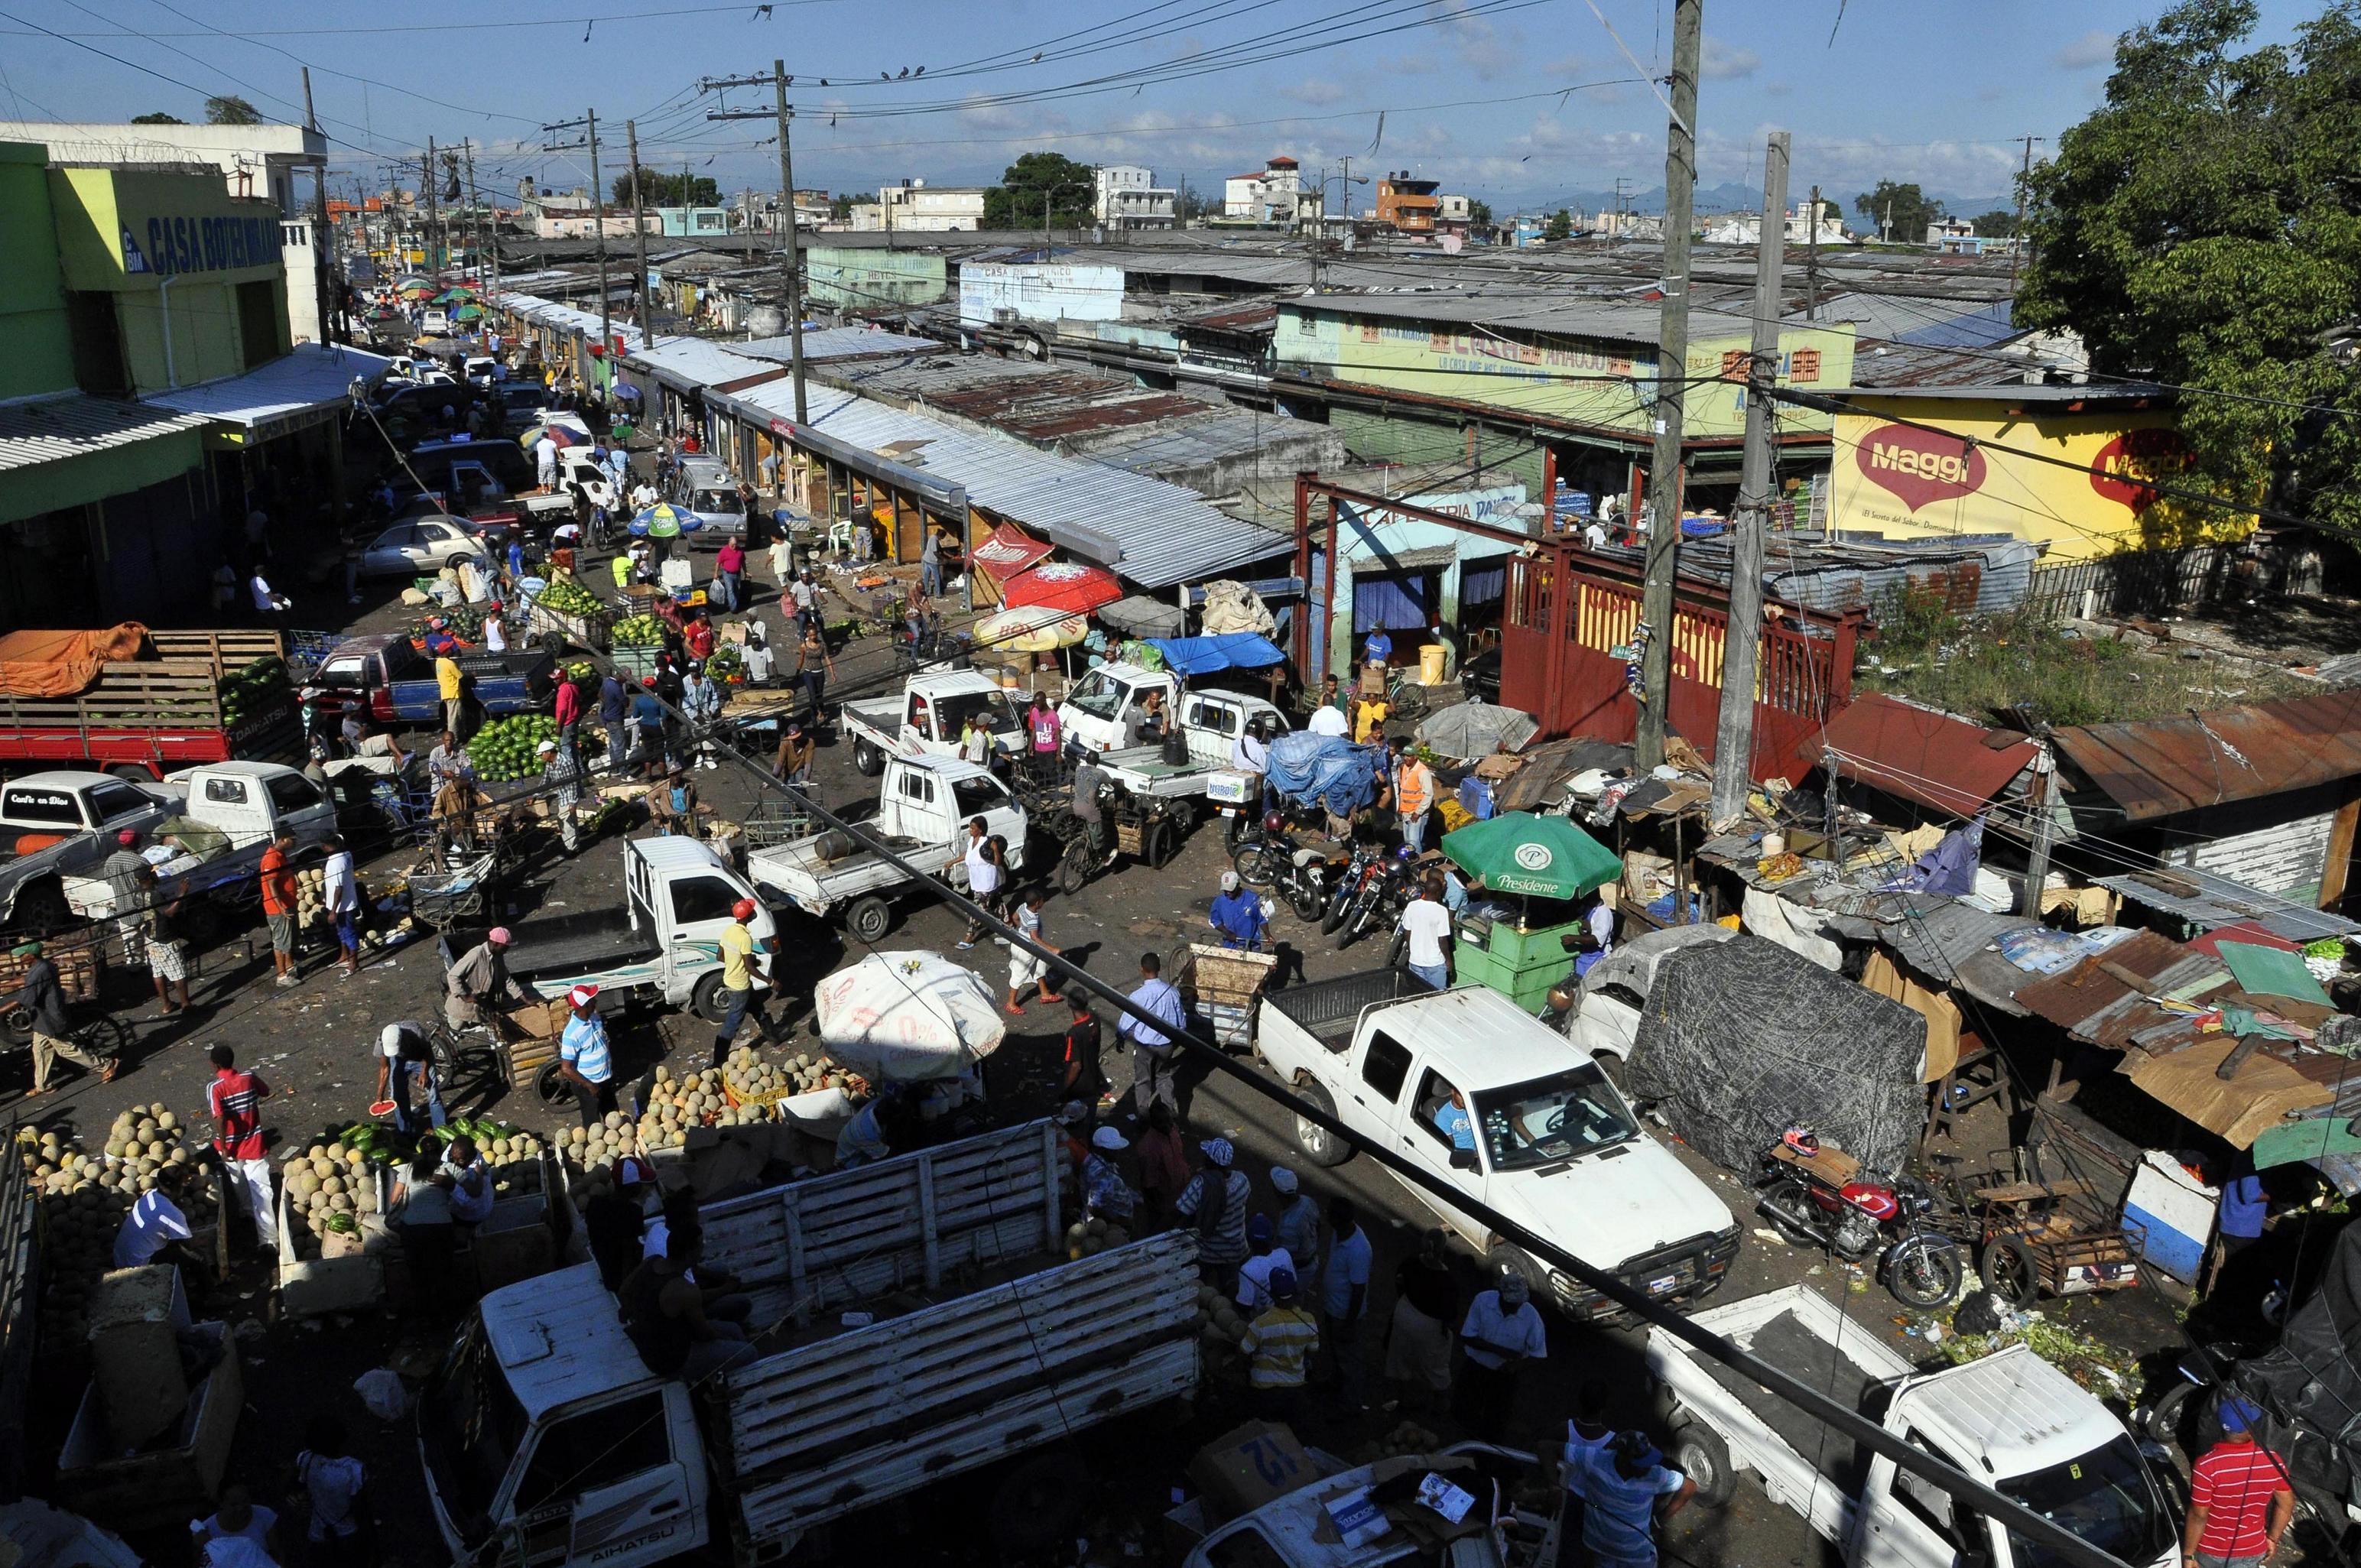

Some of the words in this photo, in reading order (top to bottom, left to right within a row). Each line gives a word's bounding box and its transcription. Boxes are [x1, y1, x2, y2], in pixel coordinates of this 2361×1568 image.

[124, 232, 132, 251] C
[148, 217, 203, 275] CASA
[126, 252, 143, 271] BM
[985, 267, 1008, 277] CASA
[1871, 442, 1969, 484] Maggi
[1871, 511, 1891, 522] Secreto
[1892, 515, 1901, 524] del
[235, 705, 288, 742] DAIHATSU
[1210, 783, 1236, 796] NORDIC
[49, 796, 68, 805] Dios
[1525, 850, 1541, 862] P
[1497, 875, 1558, 893] Presidente
[592, 1527, 674, 1563] AIHATSU
